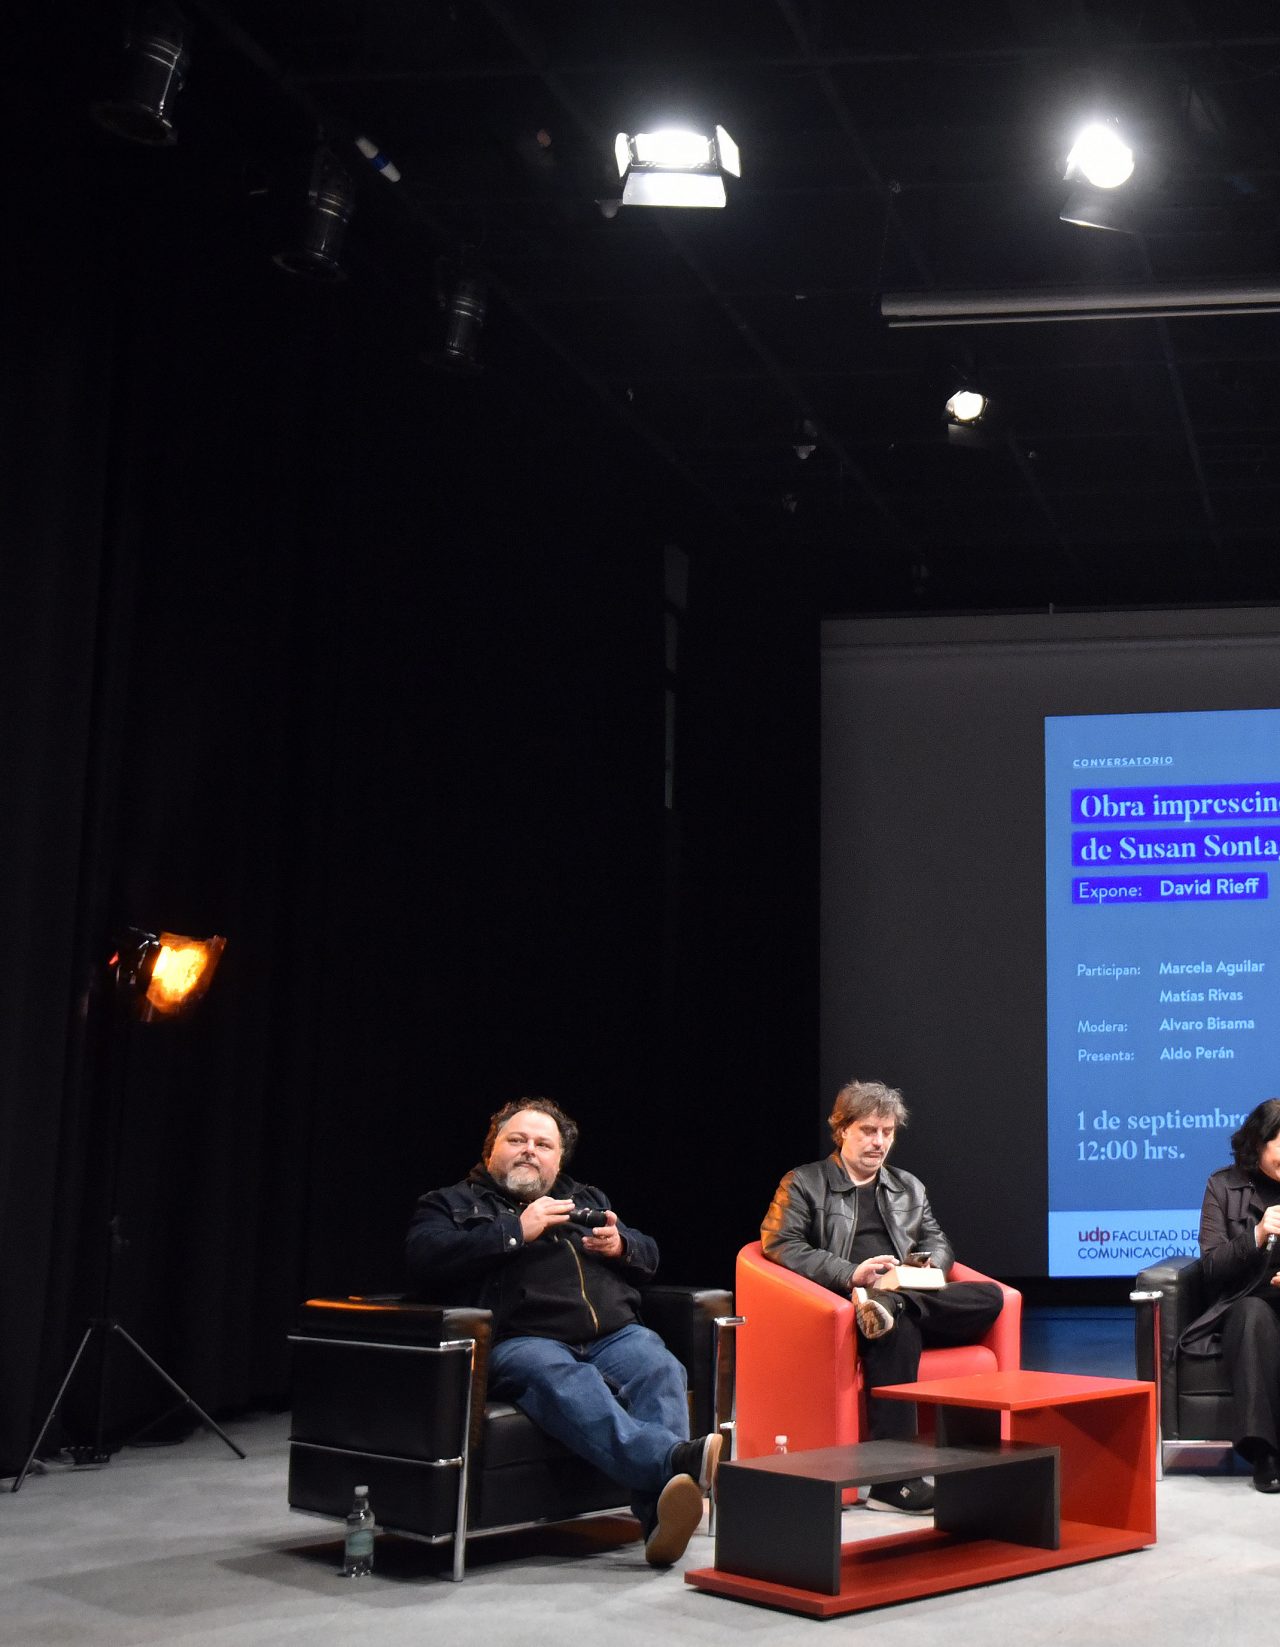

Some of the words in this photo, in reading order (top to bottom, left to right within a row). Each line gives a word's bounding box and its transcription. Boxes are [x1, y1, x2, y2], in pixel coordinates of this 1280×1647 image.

[1072, 755, 1174, 768] CONVERSATORIO
[1080, 795, 1146, 818] Obra
[1080, 837, 1112, 860] de
[1119, 836, 1197, 860] Susan
[1078, 881, 1143, 904] Expone:
[1160, 879, 1212, 897] David
[1216, 877, 1260, 895] Rieff
[1076, 963, 1141, 980] Participan:
[1158, 960, 1213, 975] Marcela
[1215, 959, 1266, 977] Aguilar
[1159, 988, 1205, 1003] Matías
[1208, 988, 1244, 1002] Rivas
[1077, 1020, 1128, 1033] Modera:
[1159, 1017, 1204, 1031] Alvaro
[1207, 1016, 1255, 1030] Bisama
[1077, 1049, 1135, 1063] Presenta:
[1160, 1046, 1192, 1060] Aldo
[1195, 1046, 1235, 1060] Perán
[1077, 1111, 1086, 1131] 1
[1093, 1109, 1121, 1131] de
[1077, 1140, 1138, 1161] 12:00
[1143, 1139, 1186, 1160] hrs.
[1078, 1227, 1111, 1245] udp
[1112, 1229, 1178, 1242] FACULTAD
[1181, 1229, 1199, 1242] DE
[1077, 1244, 1187, 1260] COMUNICACIÓN
[1187, 1246, 1198, 1258] Y
